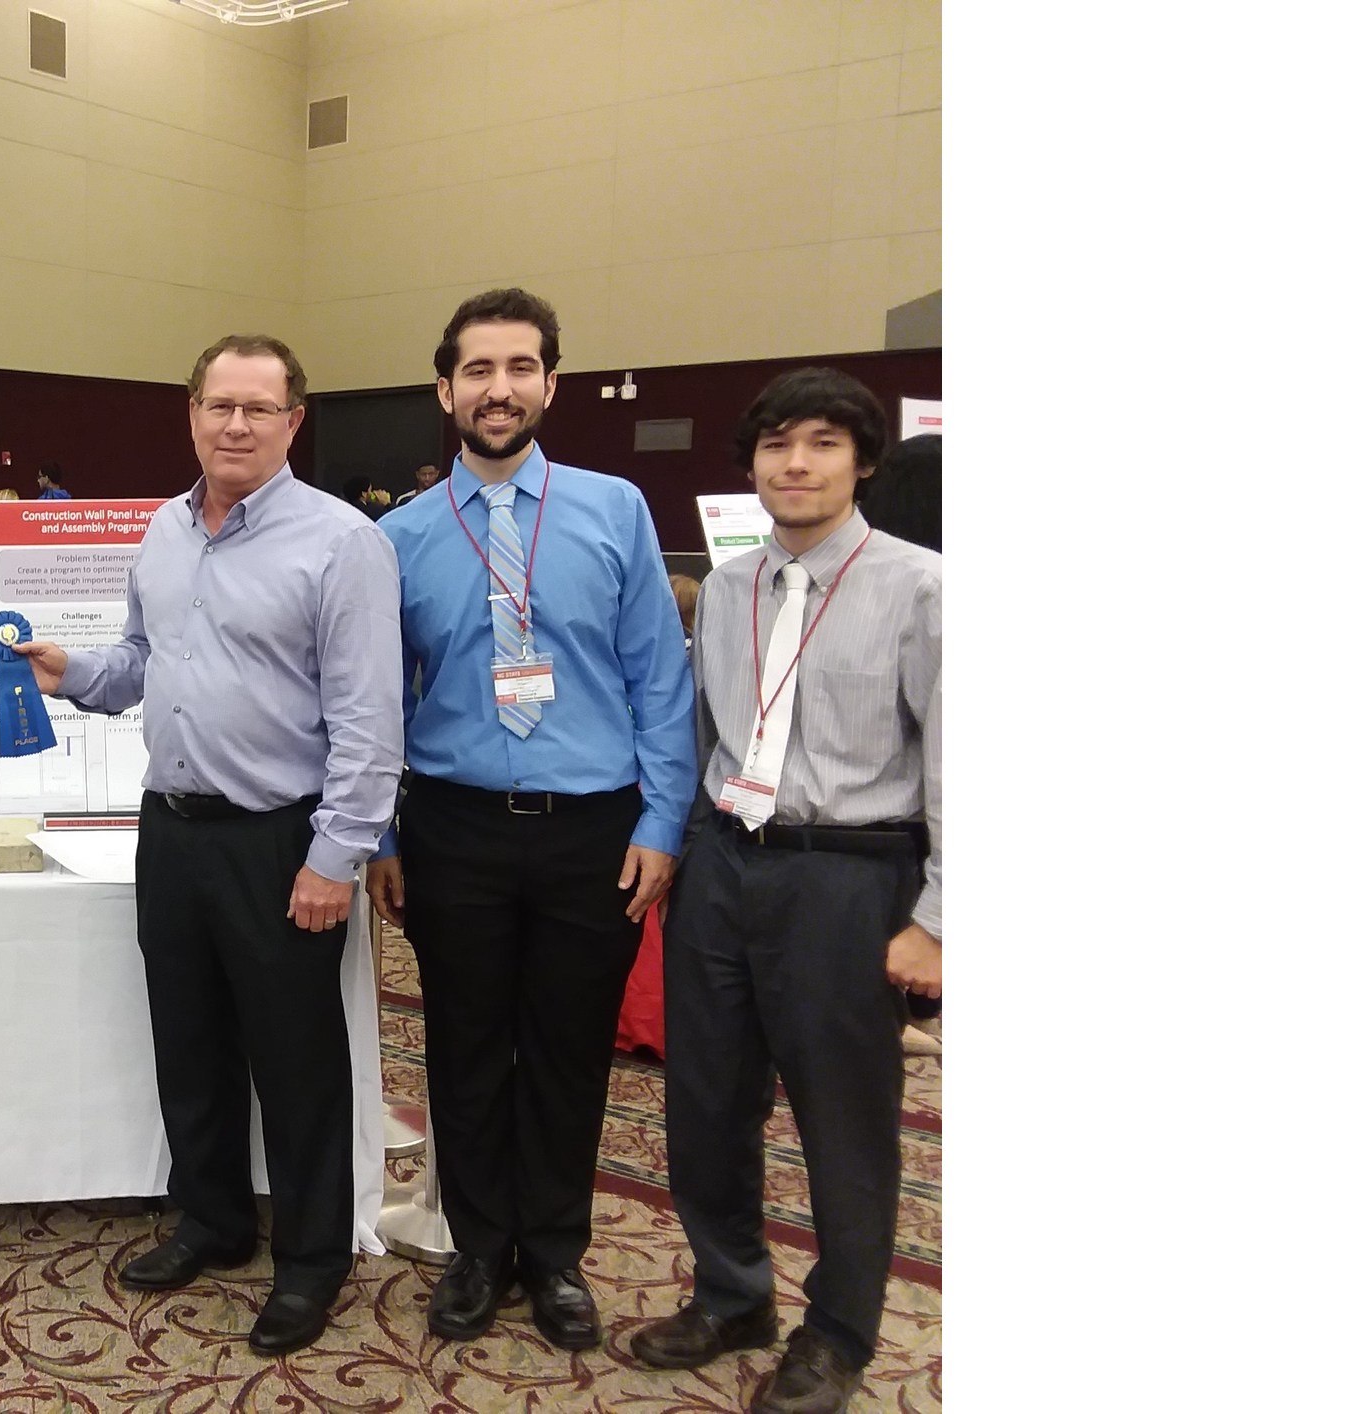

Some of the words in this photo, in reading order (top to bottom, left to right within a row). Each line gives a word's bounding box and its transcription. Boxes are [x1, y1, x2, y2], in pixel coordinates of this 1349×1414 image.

[22, 510, 82, 521] Construction
[84, 510, 105, 520] Wall
[107, 509, 132, 520] Panel
[135, 509, 156, 522] Layo
[41, 523, 60, 533] and
[61, 522, 106, 534] Assembly
[108, 522, 147, 534] Program
[56, 555, 91, 563] Problem
[92, 554, 135, 562] Statement
[17, 566, 42, 574] Create
[50, 567, 82, 575] program
[93, 566, 125, 574] optimize
[51, 577, 81, 585] through
[82, 576, 126, 585] importation
[44, 587, 59, 595] and
[91, 587, 127, 595] inventory
[61, 612, 102, 621] Challenges
[48, 712, 91, 721] portation
